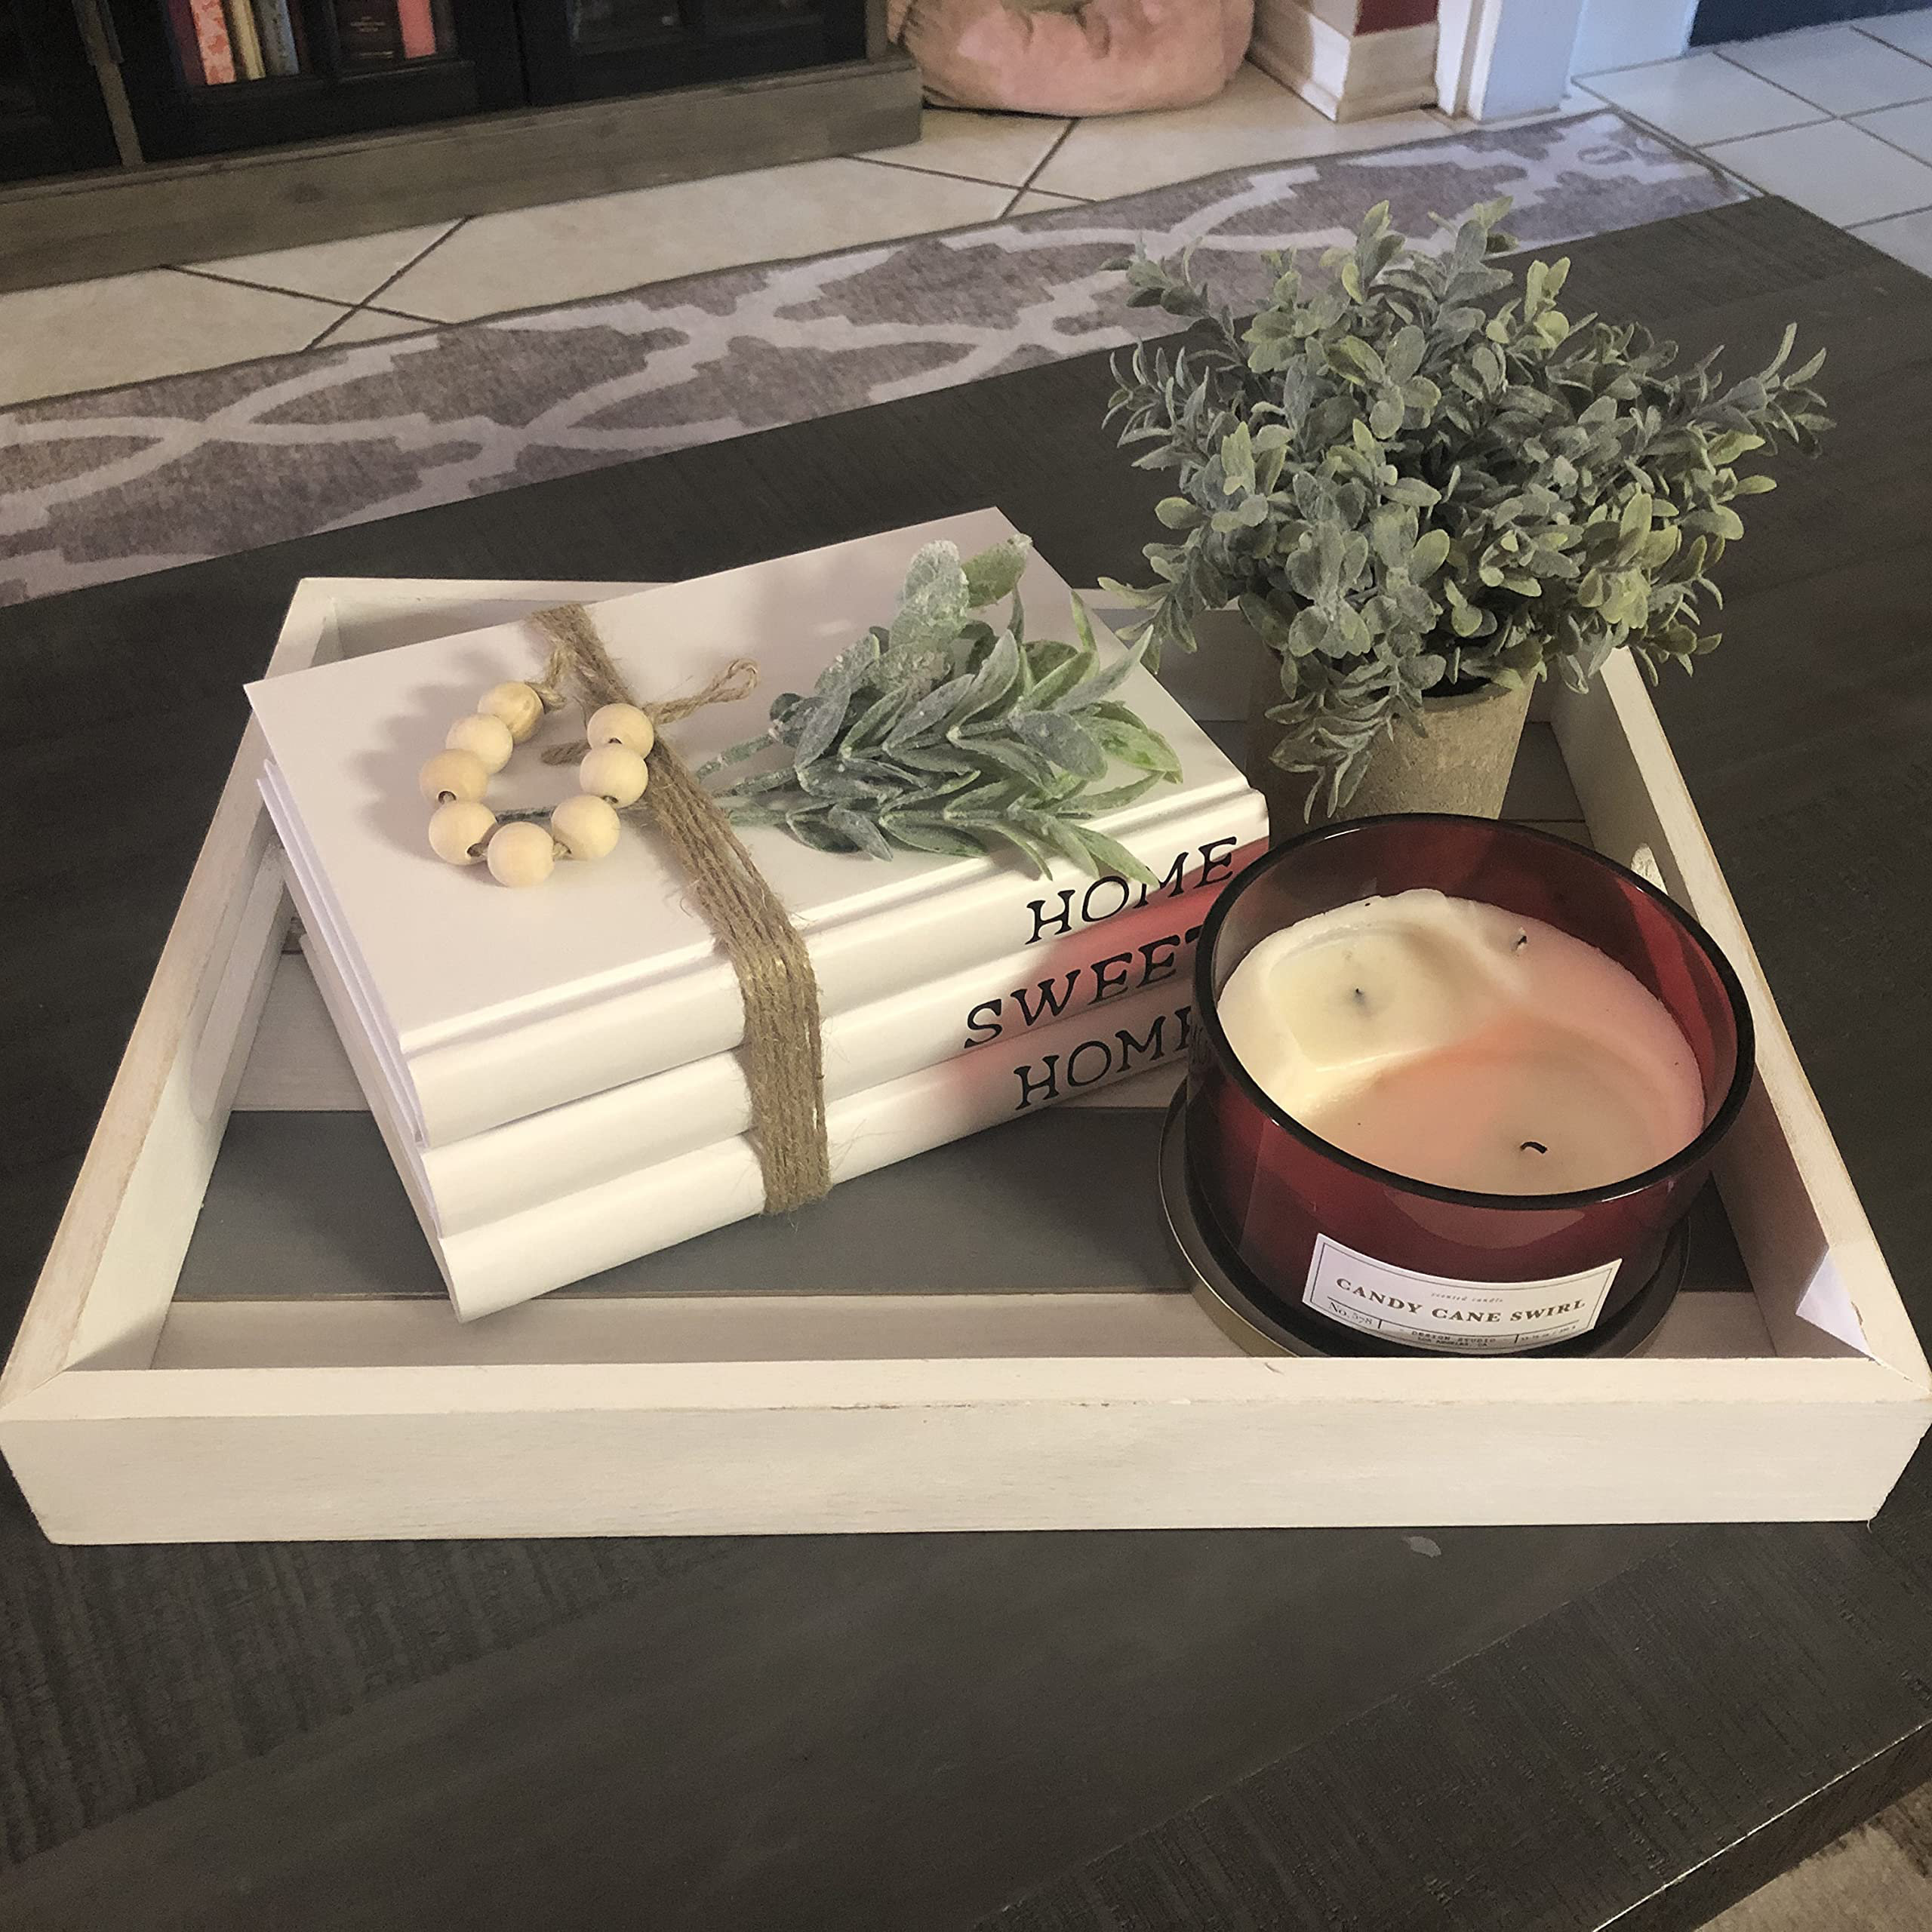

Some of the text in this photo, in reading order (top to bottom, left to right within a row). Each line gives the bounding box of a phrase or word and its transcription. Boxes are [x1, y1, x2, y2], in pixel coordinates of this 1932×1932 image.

[1024, 836, 1237, 946] HOME
[1336, 1277, 1586, 1323] CANDY CANE SWIRL
